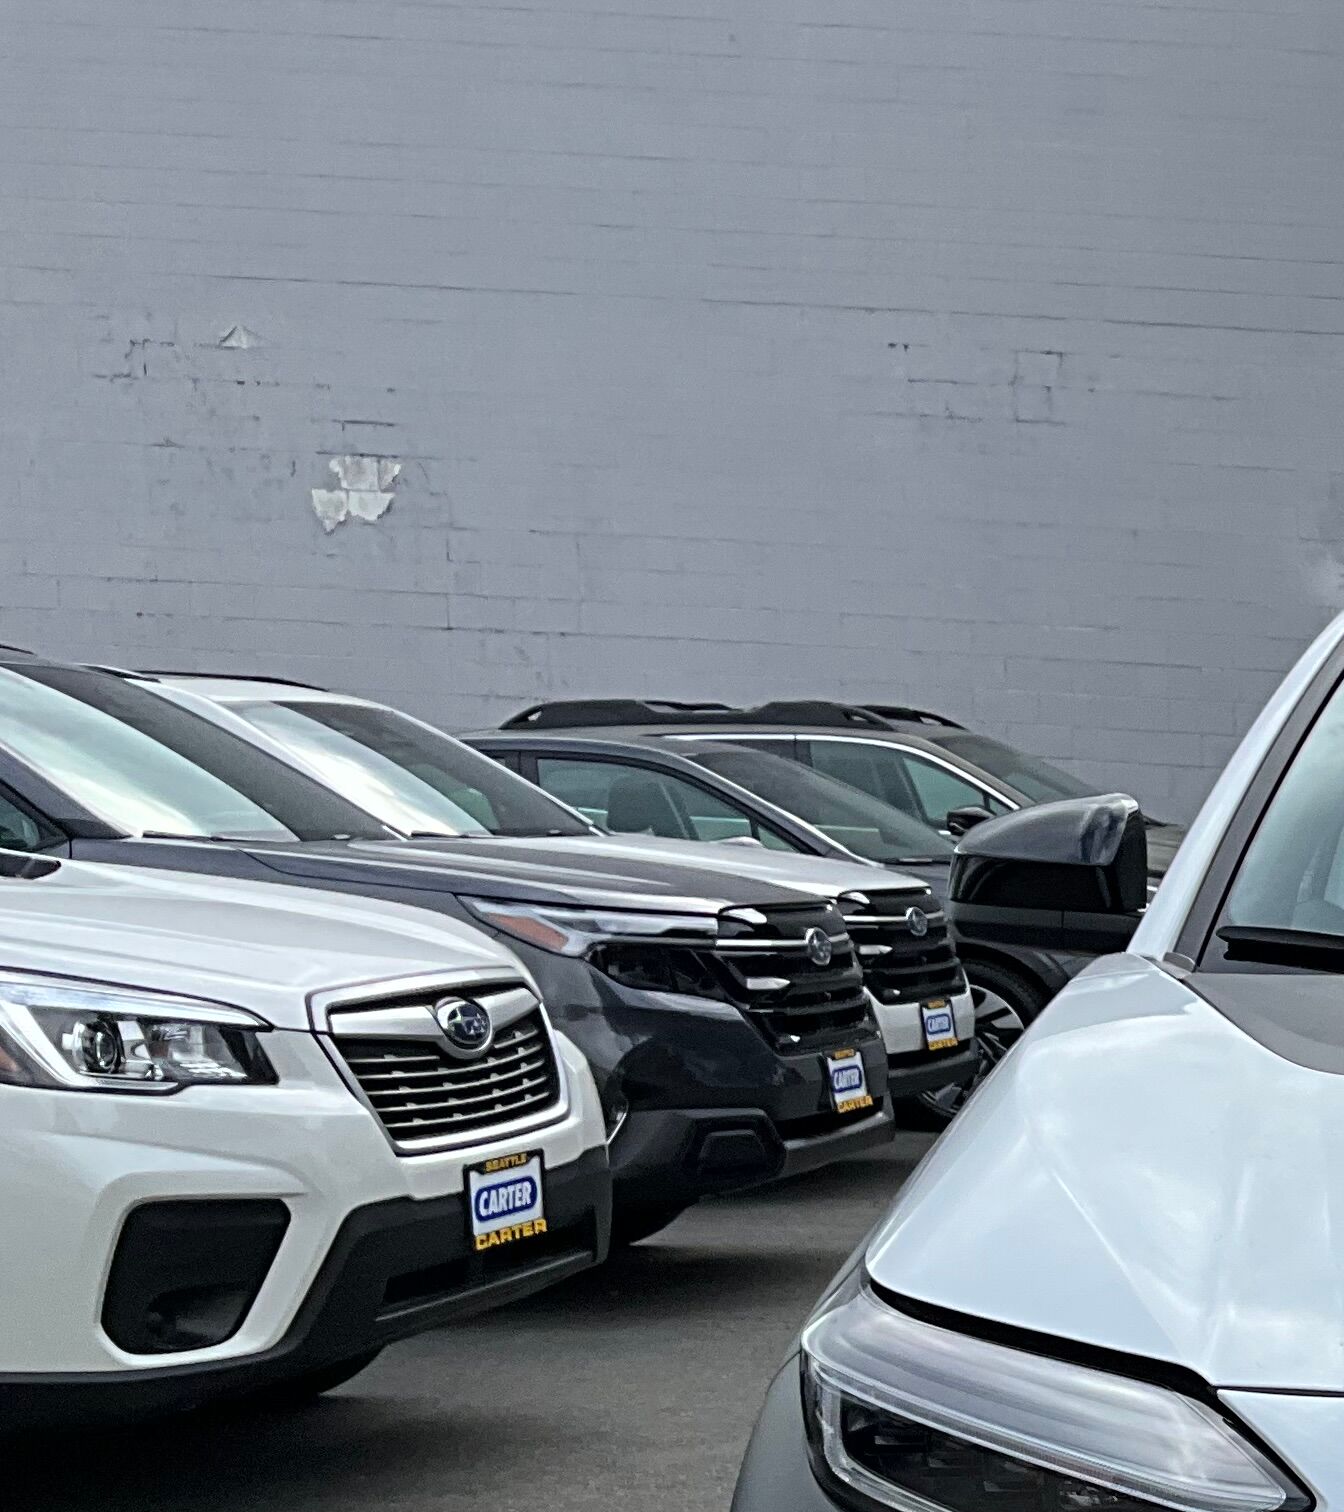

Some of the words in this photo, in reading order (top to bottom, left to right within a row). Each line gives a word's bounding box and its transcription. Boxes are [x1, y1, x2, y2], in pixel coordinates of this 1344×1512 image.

[485, 1153, 528, 1172] SEATTLE
[479, 1181, 531, 1216] CARTER
[475, 1218, 547, 1250] CARTER
